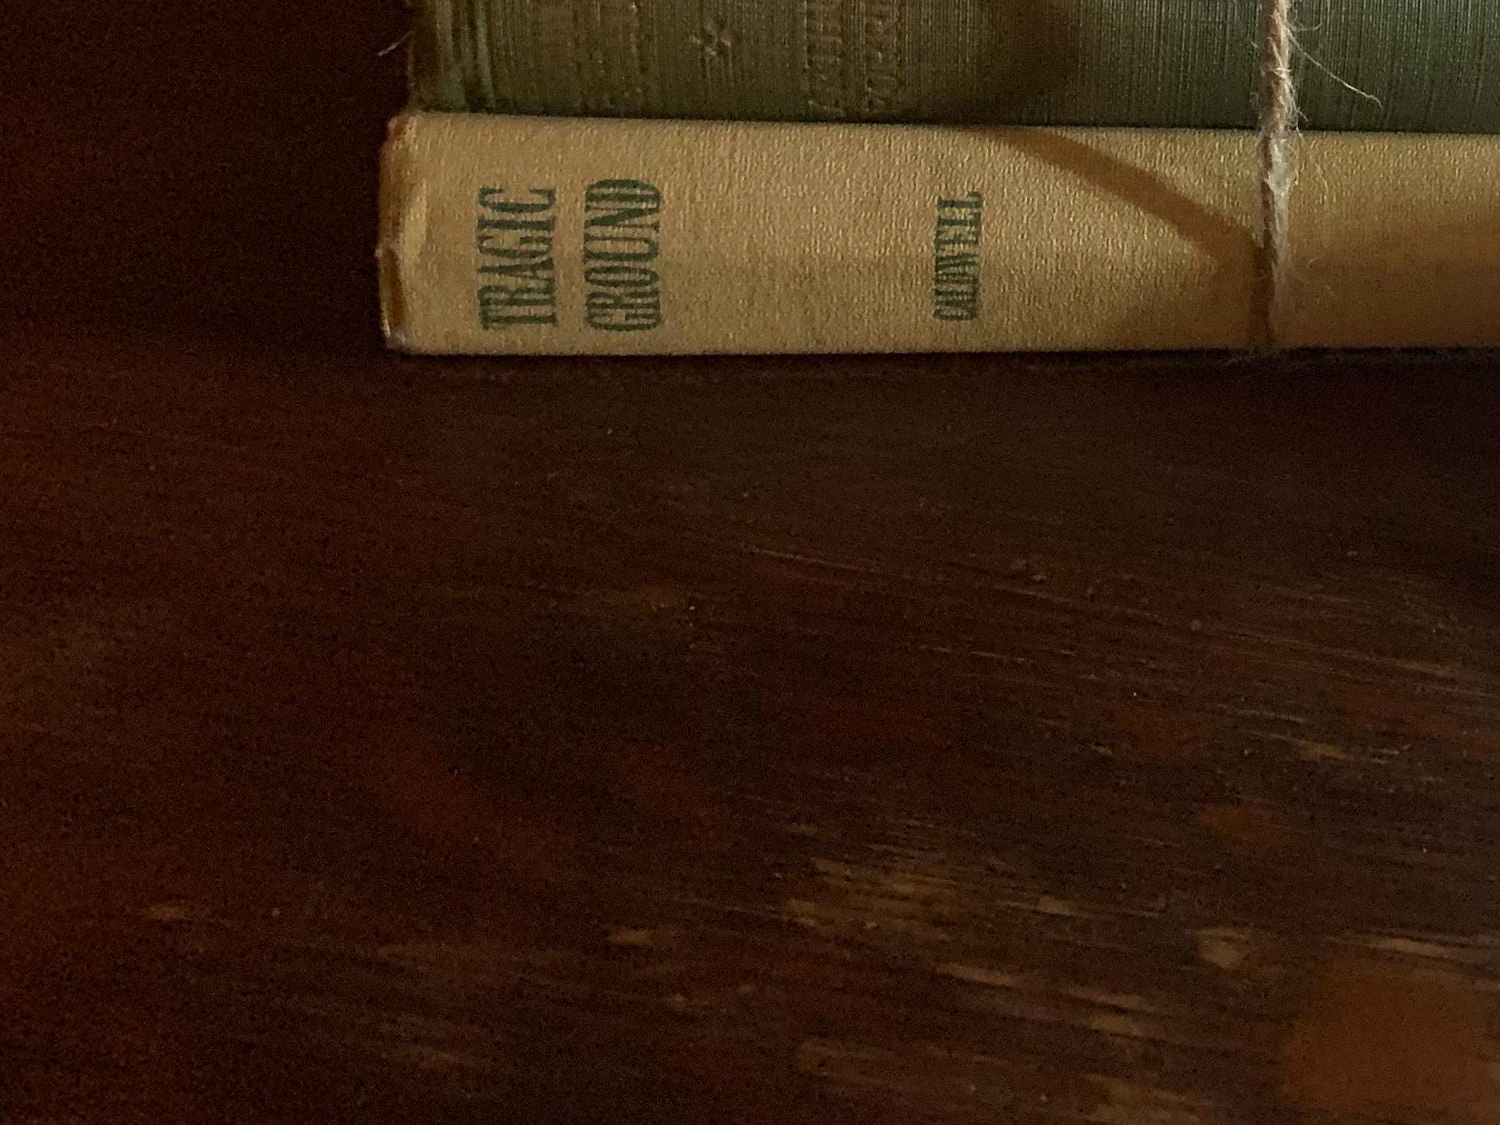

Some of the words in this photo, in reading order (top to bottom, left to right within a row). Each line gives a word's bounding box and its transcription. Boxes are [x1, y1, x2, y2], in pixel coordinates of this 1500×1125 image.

[477, 187, 557, 330] TRAGIC
[583, 178, 661, 332] GROUND
[933, 191, 983, 321] CALDWELL
